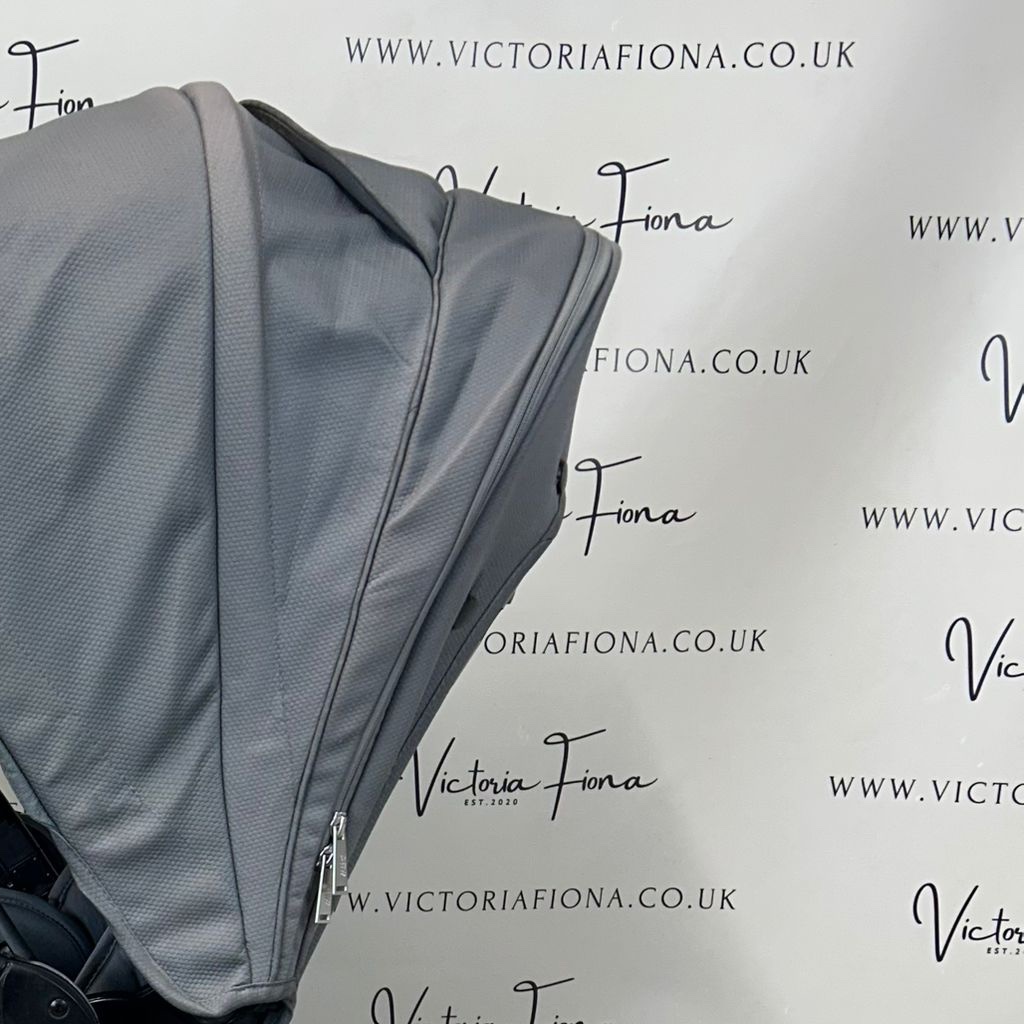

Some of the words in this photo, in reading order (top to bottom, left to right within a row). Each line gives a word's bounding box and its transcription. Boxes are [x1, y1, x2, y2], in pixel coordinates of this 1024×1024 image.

[346, 37, 855, 70] WWW.VICTORIAFIONA.CO.UK
[597, 158, 733, 243] Fiona
[584, 347, 811, 375] FIONA.CO.UK
[575, 456, 698, 556] Fiona
[862, 507, 1024, 532] WWW.VIC
[399, 737, 541, 817] Victoria
[543, 729, 658, 821] Fiona
